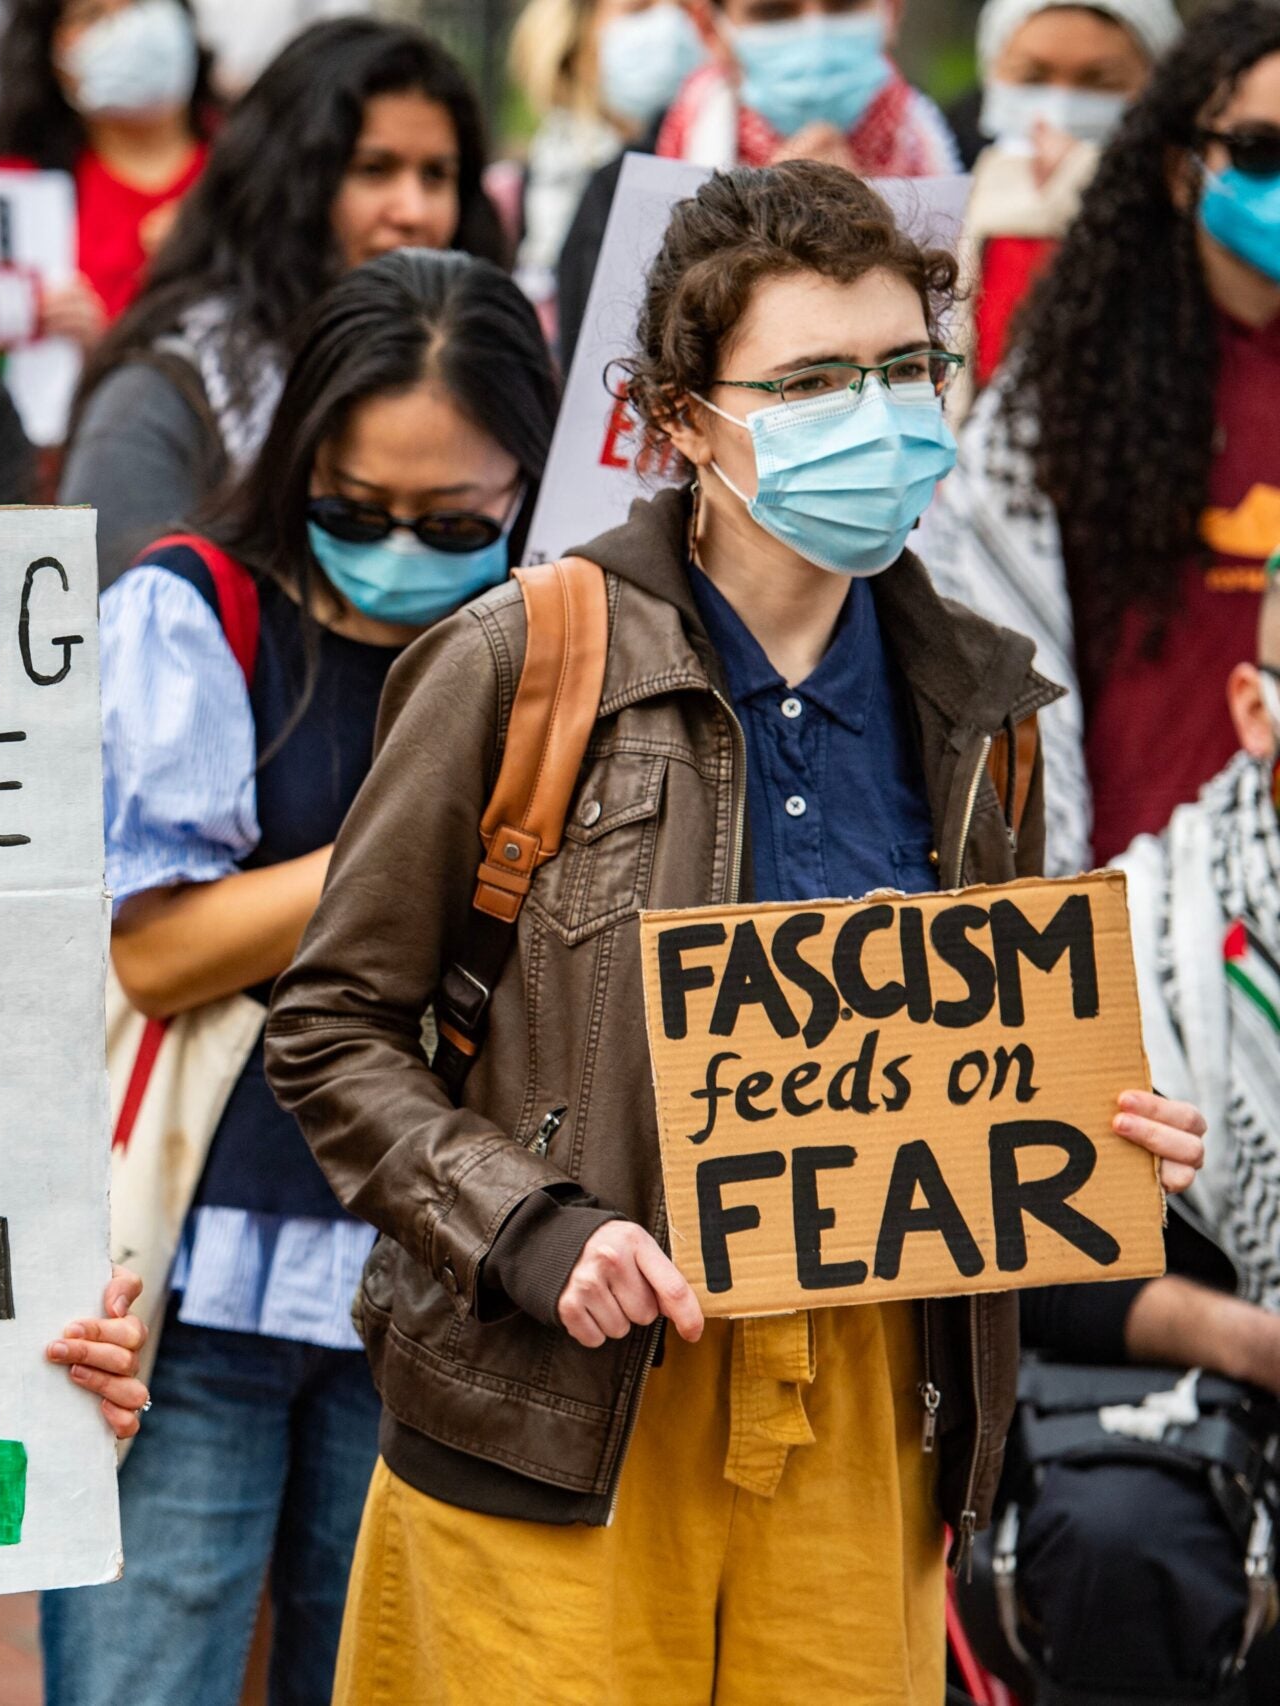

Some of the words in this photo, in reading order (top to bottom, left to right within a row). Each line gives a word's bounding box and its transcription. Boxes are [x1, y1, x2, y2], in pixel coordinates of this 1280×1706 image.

[658, 894, 1100, 1048] FASCISM
[687, 1029, 912, 1145] feeds
[948, 1043, 1040, 1105] on
[696, 1119, 1121, 1294] FEAR
